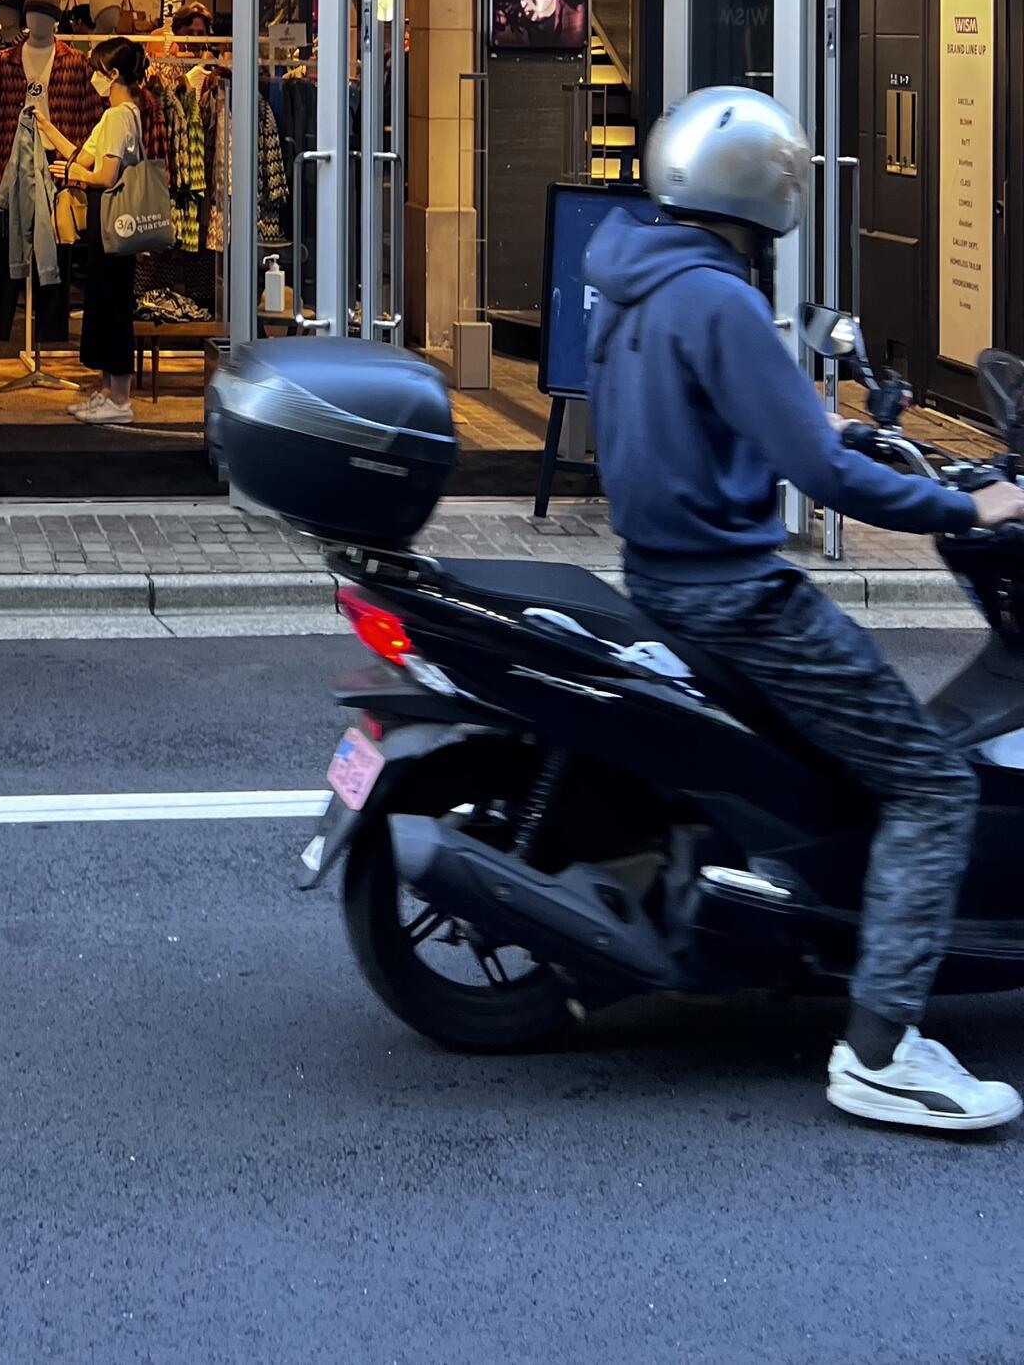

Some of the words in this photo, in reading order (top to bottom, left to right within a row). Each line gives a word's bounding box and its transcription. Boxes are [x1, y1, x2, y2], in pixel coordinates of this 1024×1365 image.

[955, 17, 977, 33] WISM
[947, 44, 964, 55] BRAND
[965, 44, 977, 55] LINE
[978, 45, 986, 55] UP
[136, 214, 162, 224] three
